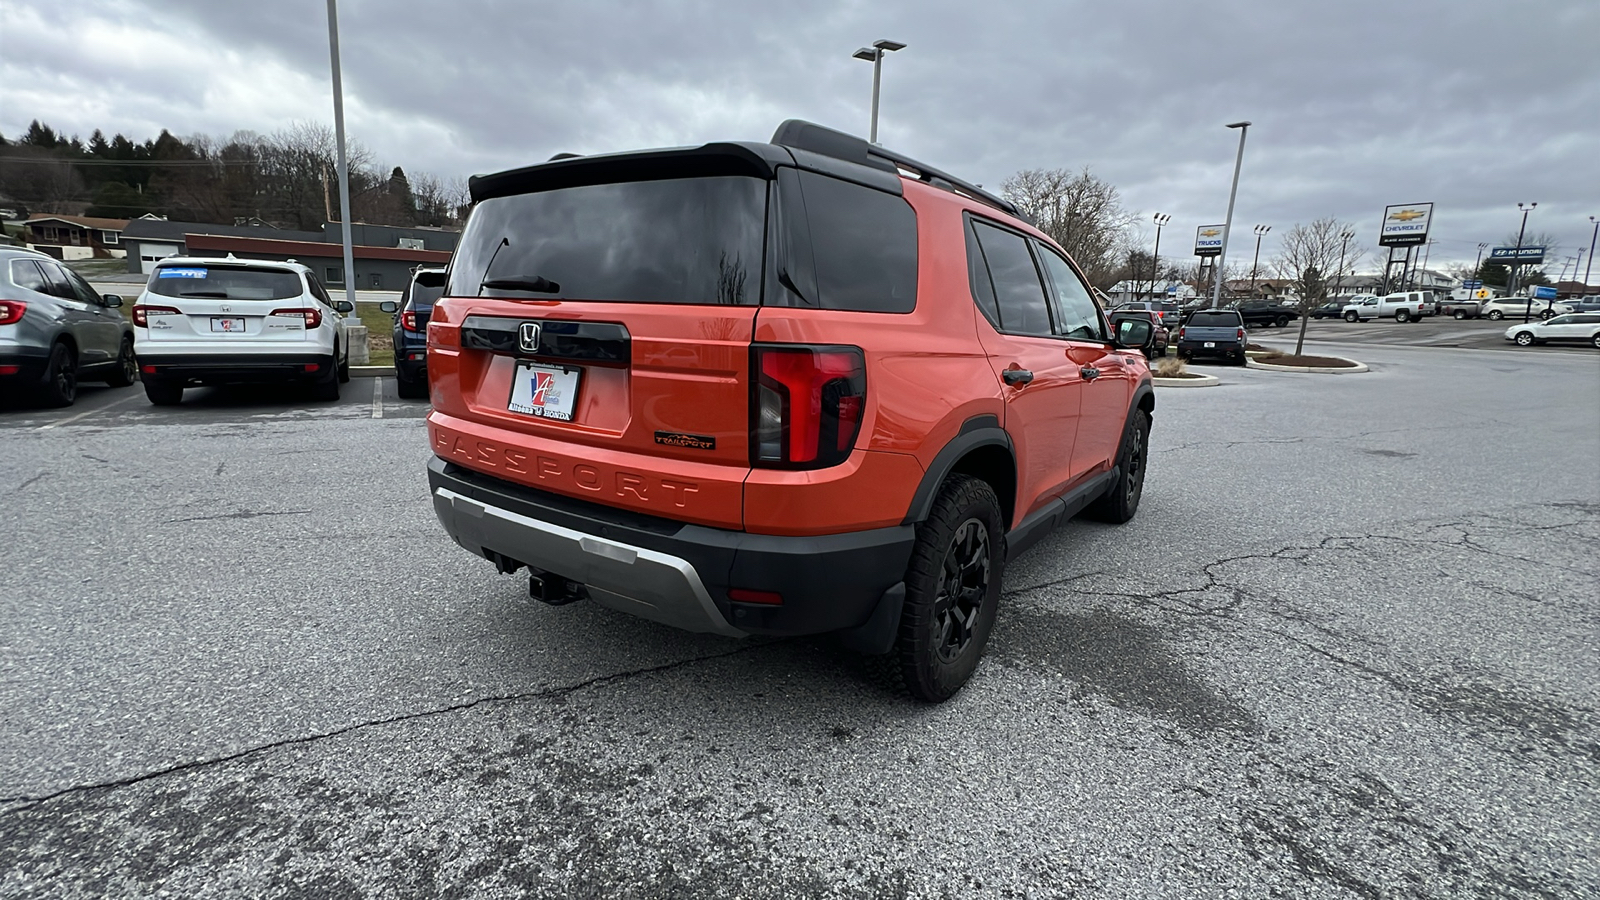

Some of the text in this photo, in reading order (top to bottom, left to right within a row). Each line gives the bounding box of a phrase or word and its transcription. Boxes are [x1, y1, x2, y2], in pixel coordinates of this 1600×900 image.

[1385, 224, 1424, 232] CHEVROLET
[655, 436, 713, 448] TRAILSPORT
[434, 428, 700, 507] PASSPORT
